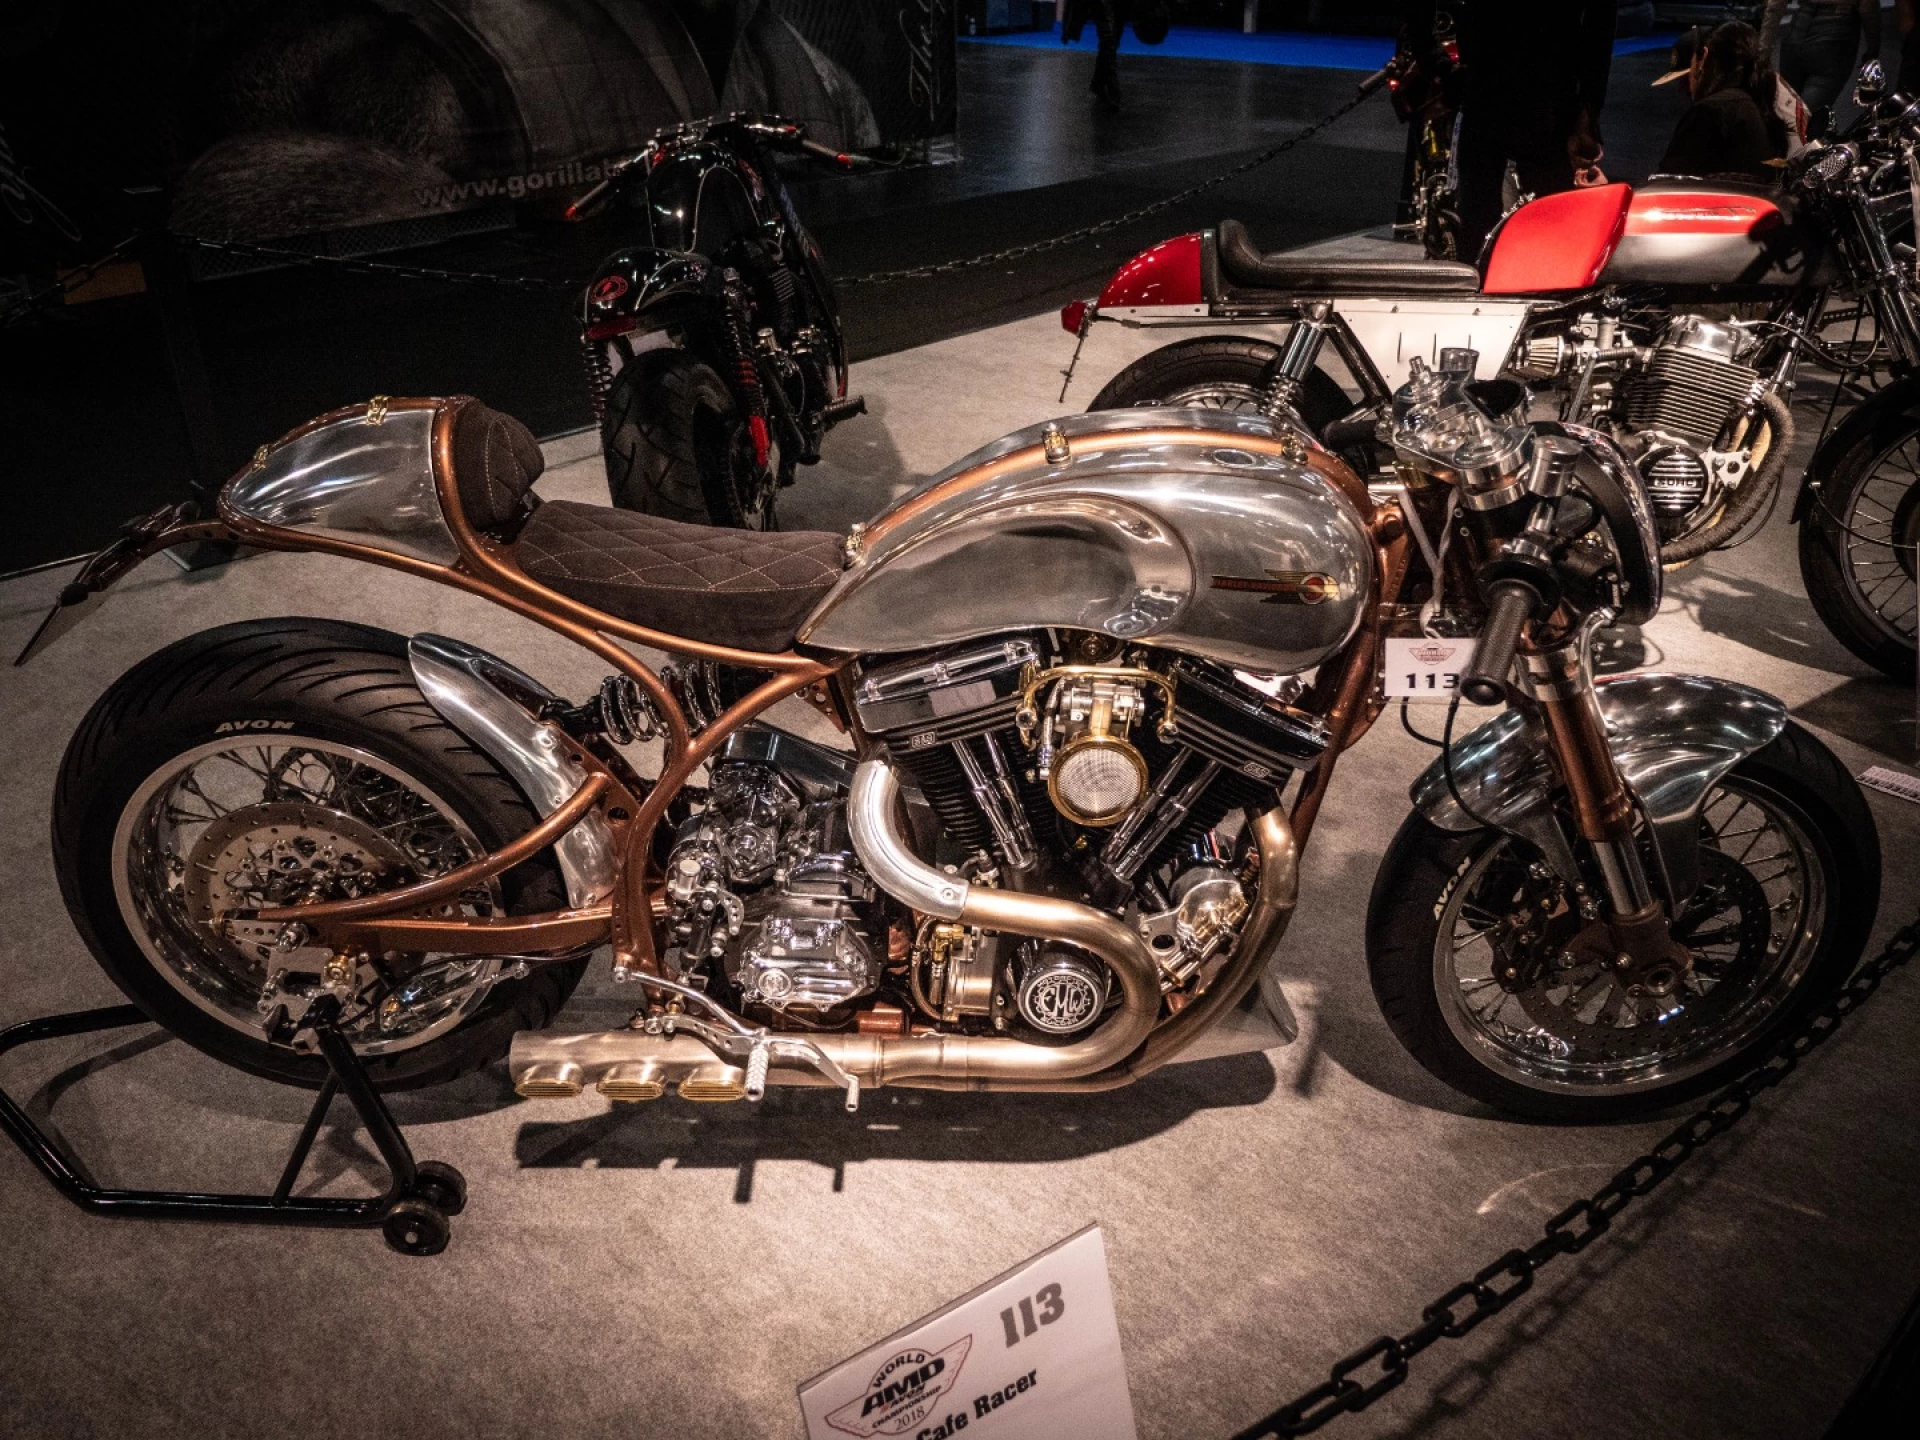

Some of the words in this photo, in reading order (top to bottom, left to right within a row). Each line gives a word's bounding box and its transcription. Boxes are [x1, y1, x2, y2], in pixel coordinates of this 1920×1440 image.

[1406, 673, 1460, 689] 113
[214, 720, 295, 733] AVON
[1433, 856, 1471, 920] AVON
[1000, 1283, 1065, 1348] 113
[860, 1358, 945, 1418] AMD
[873, 1353, 925, 1388] WORLD
[872, 1385, 942, 1428] CHAMPIONSHIP
[973, 1368, 1037, 1420] Racer
[894, 1405, 926, 1431] 2018
